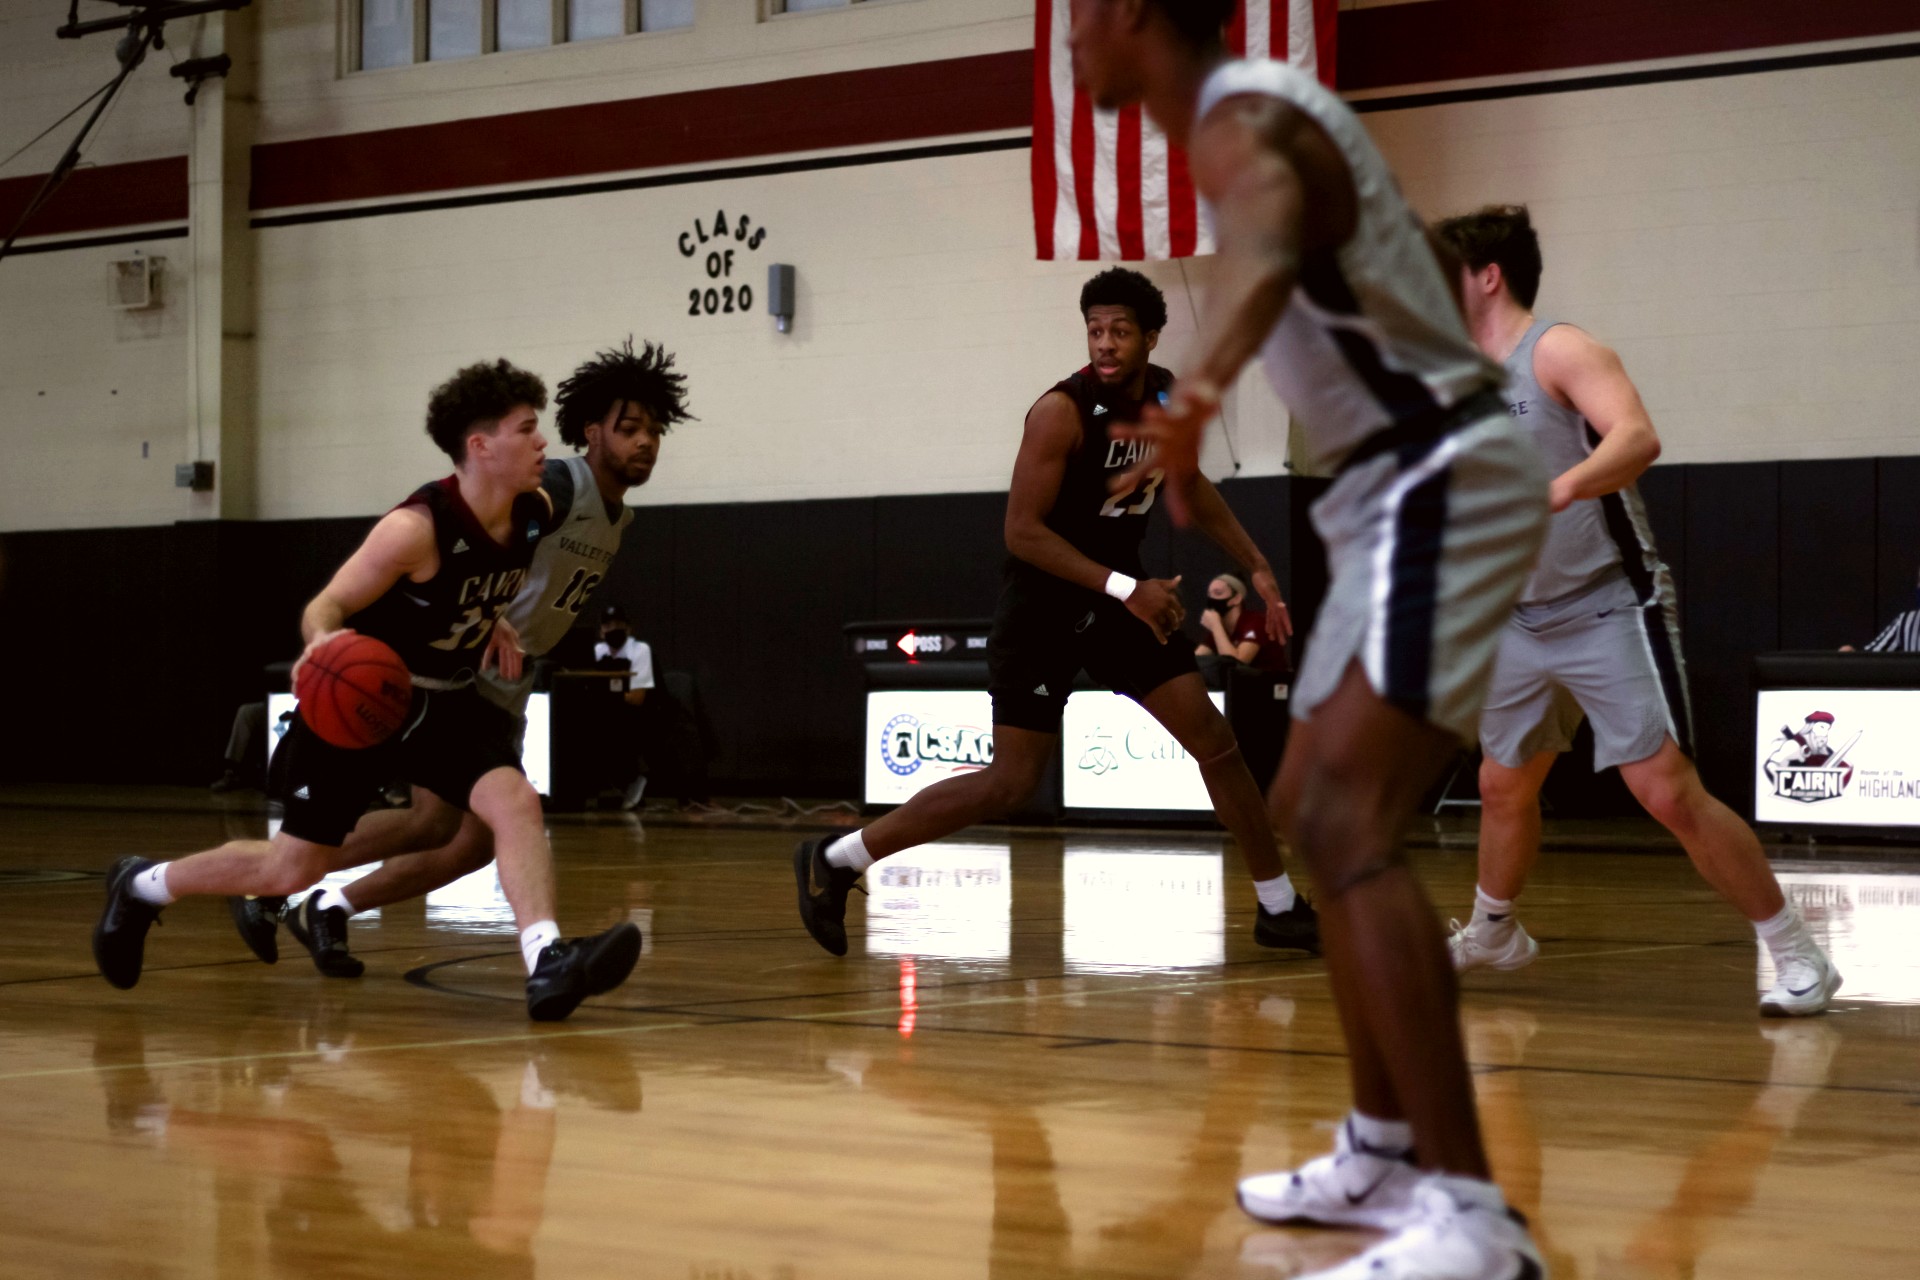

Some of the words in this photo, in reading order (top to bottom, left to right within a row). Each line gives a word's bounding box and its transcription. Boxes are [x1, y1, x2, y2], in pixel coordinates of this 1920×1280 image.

[678, 209, 766, 257] CLASS
[706, 249, 734, 278] OF
[688, 284, 752, 316] 2020
[1104, 438, 1151, 469] CAI
[1779, 772, 1838, 798] CAIRN
